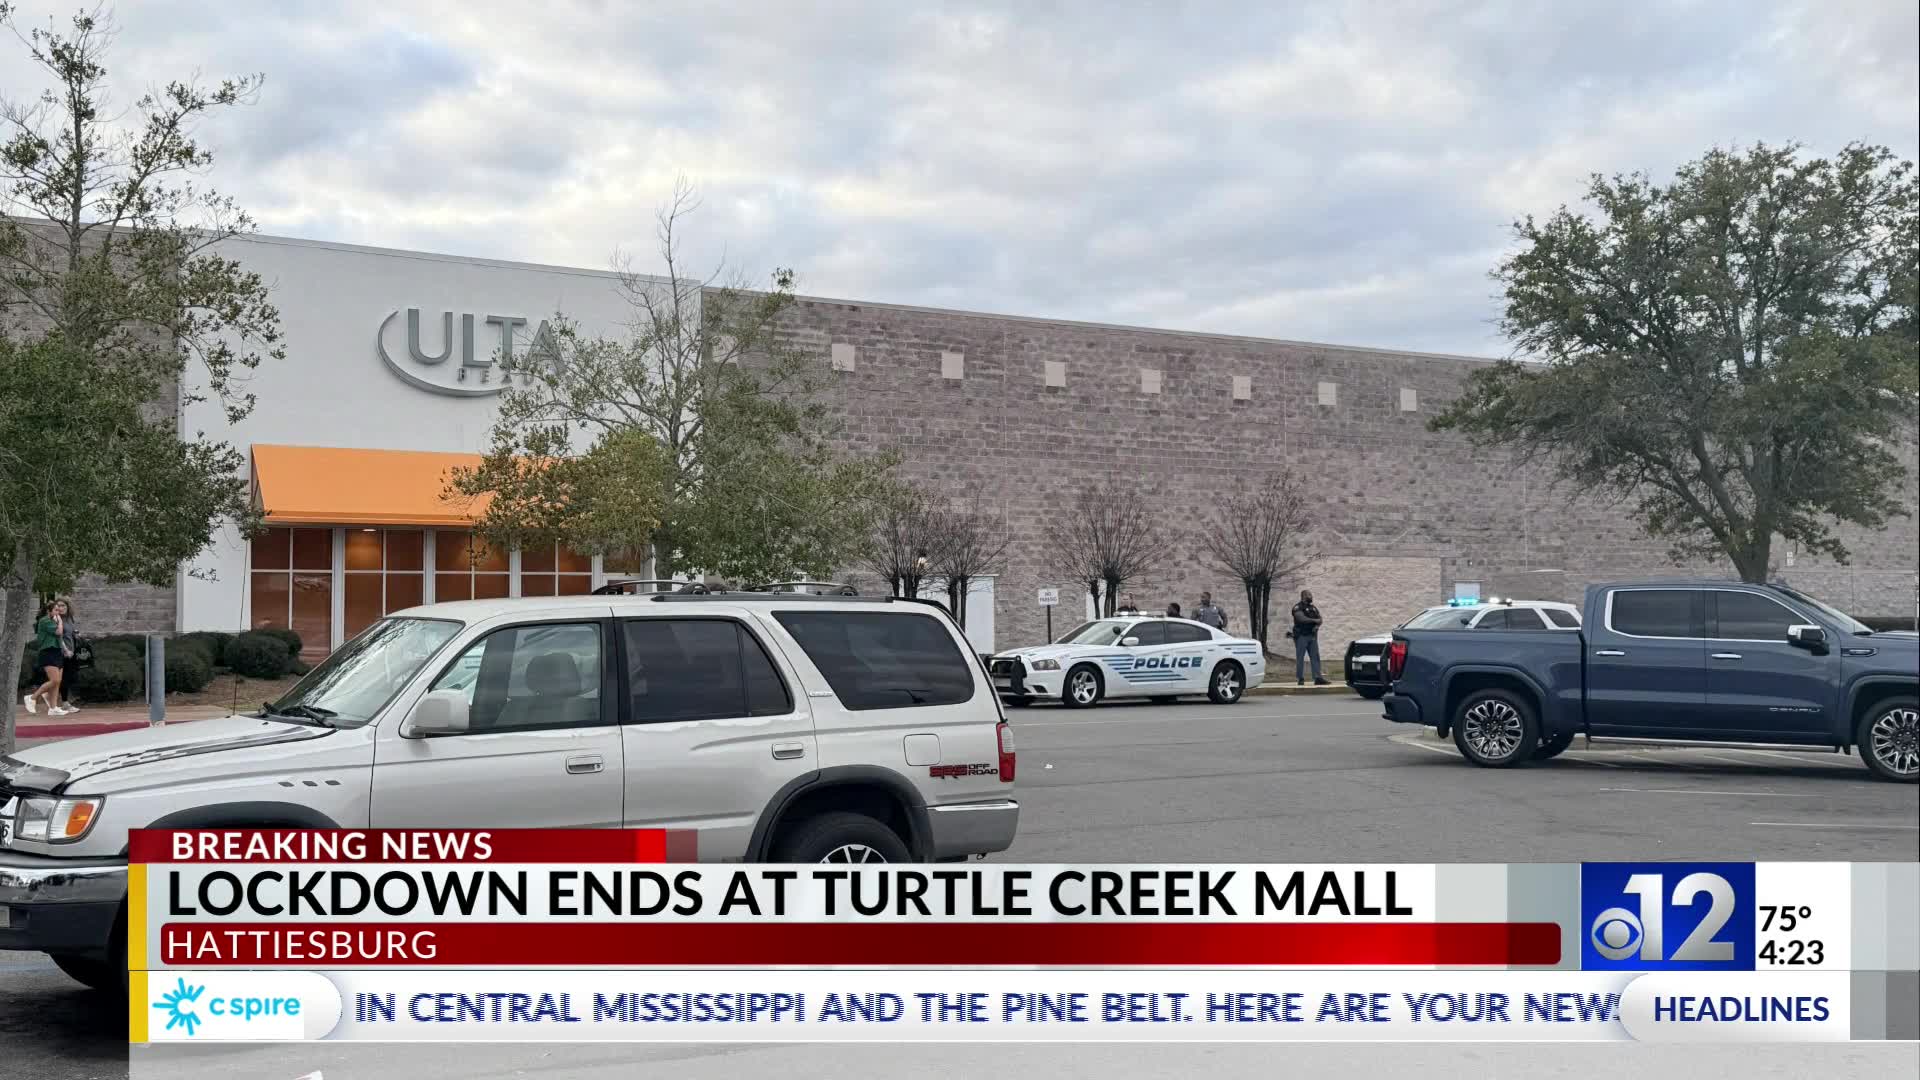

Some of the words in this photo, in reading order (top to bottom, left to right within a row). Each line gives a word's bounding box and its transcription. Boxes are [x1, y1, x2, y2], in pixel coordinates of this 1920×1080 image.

[407, 308, 567, 376] ULTA
[1133, 656, 1203, 669] POLICE
[968, 768, 999, 776] ROAD
